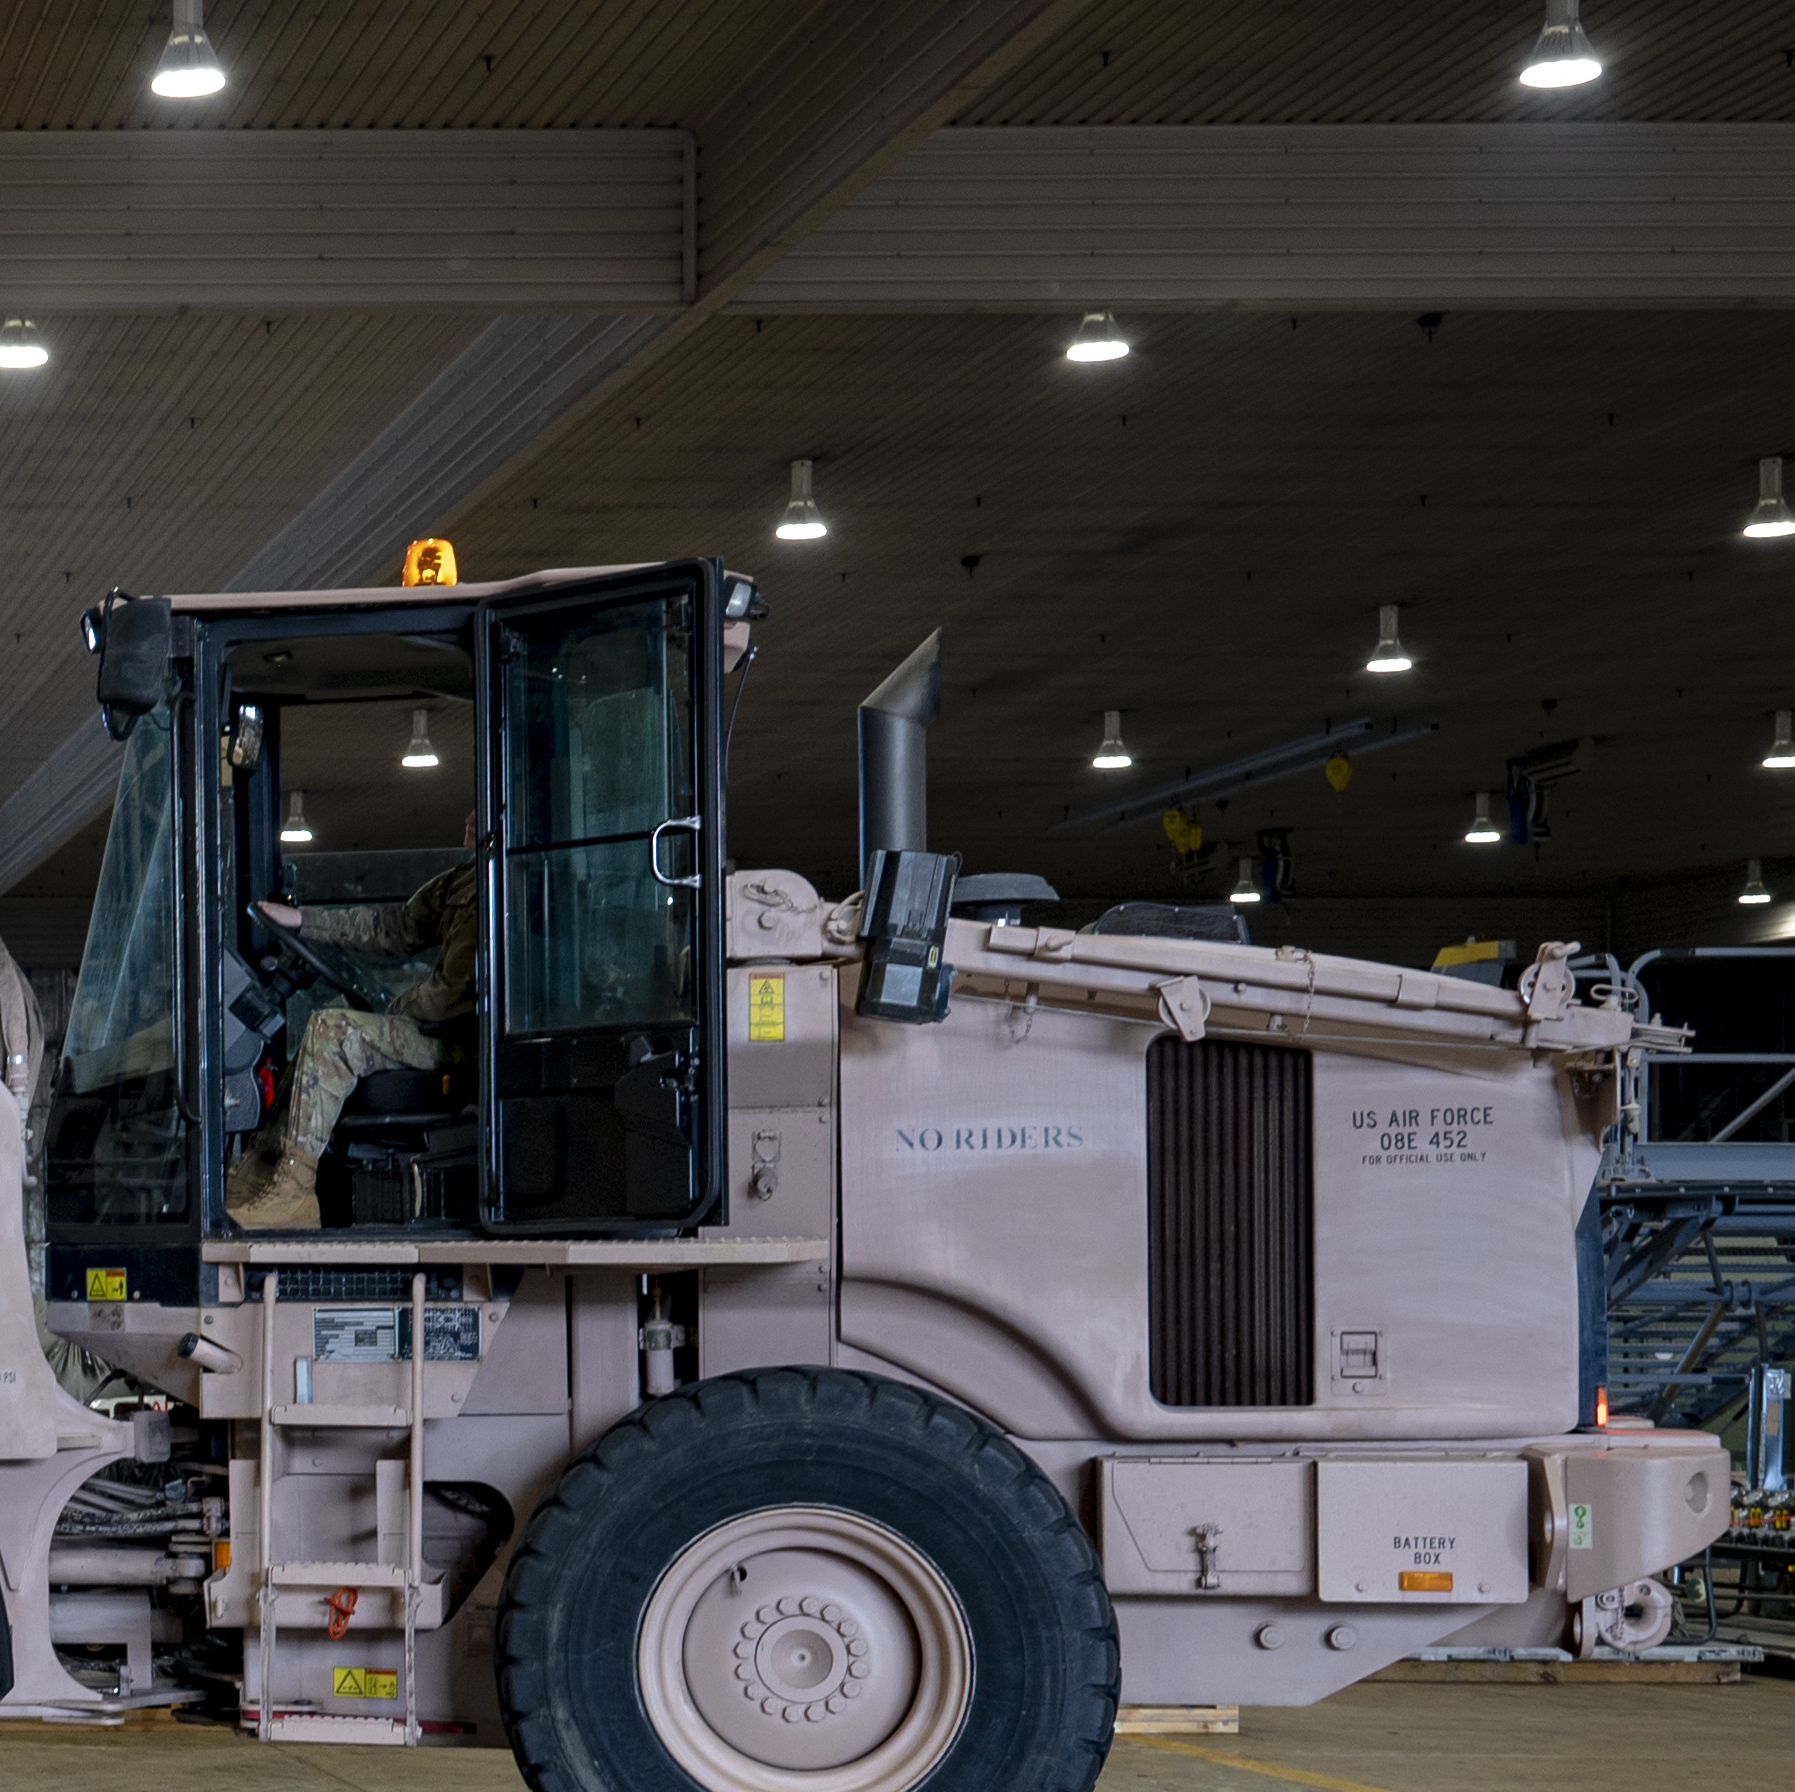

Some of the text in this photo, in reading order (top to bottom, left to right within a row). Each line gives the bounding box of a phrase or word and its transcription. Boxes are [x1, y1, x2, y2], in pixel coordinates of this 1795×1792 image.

[1352, 1106, 1494, 1129] US AIR FORCE
[896, 1125, 1084, 1151] NO RIDERS
[1380, 1130, 1468, 1151] 08E 452
[1362, 1151, 1487, 1165] FOR OFFICIAL USE ONLY
[3, 1371, 17, 1384] PSI
[1393, 1536, 1456, 1550] BATTERY
[1413, 1551, 1441, 1565] BOX
